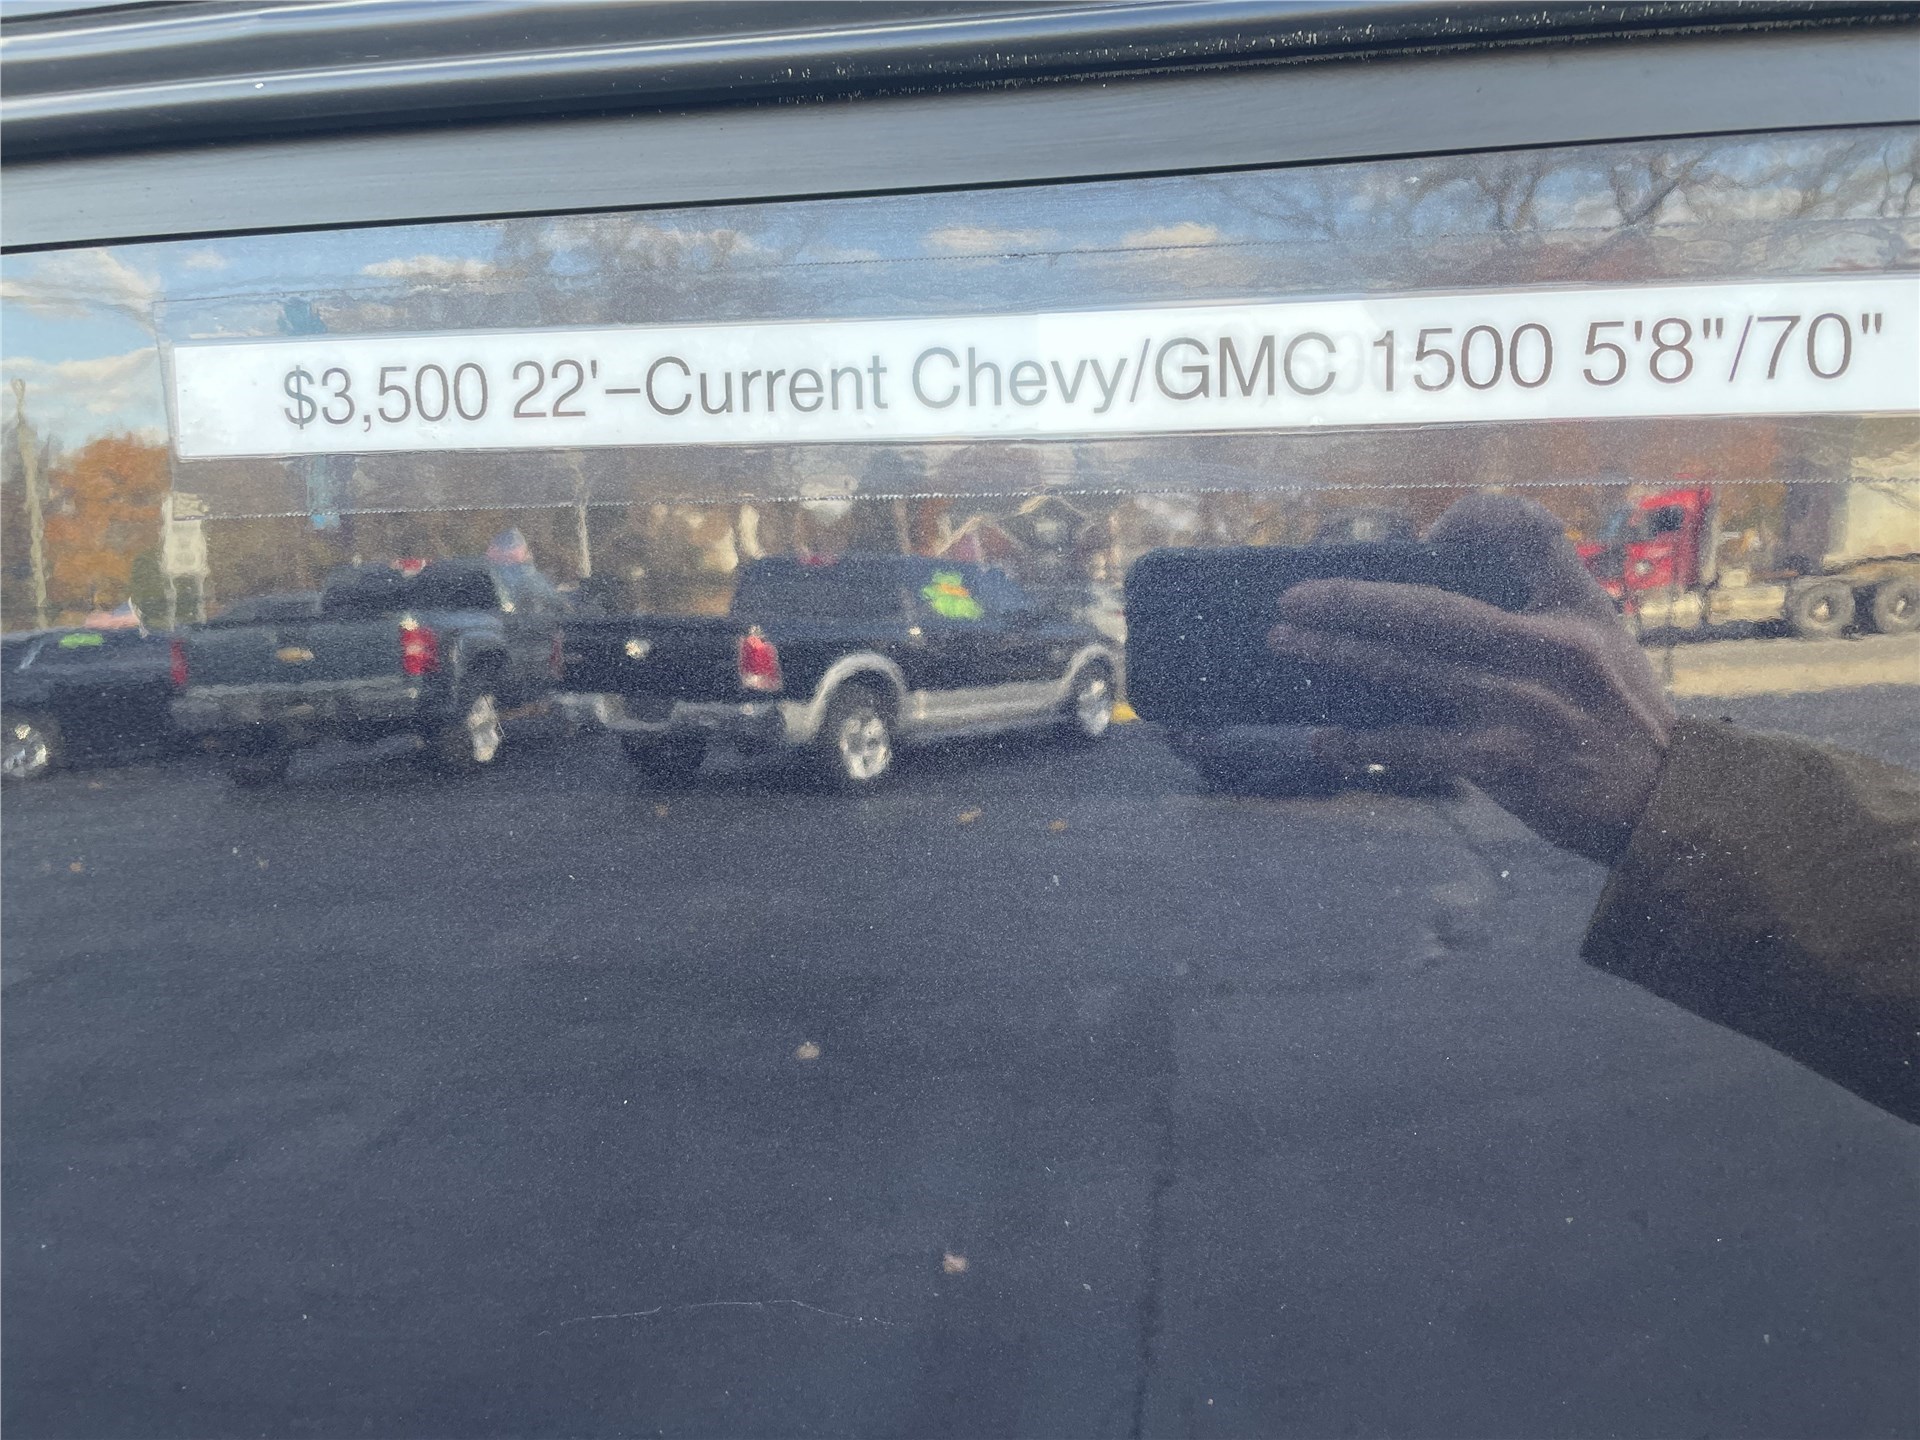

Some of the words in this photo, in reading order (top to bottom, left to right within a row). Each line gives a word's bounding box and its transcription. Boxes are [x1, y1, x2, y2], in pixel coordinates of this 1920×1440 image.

[283, 365, 490, 433] $3,500
[911, 331, 1338, 413] Chevy/GMC
[1373, 323, 1554, 392] 1500
[1582, 312, 1883, 386] 5'8"/70"
